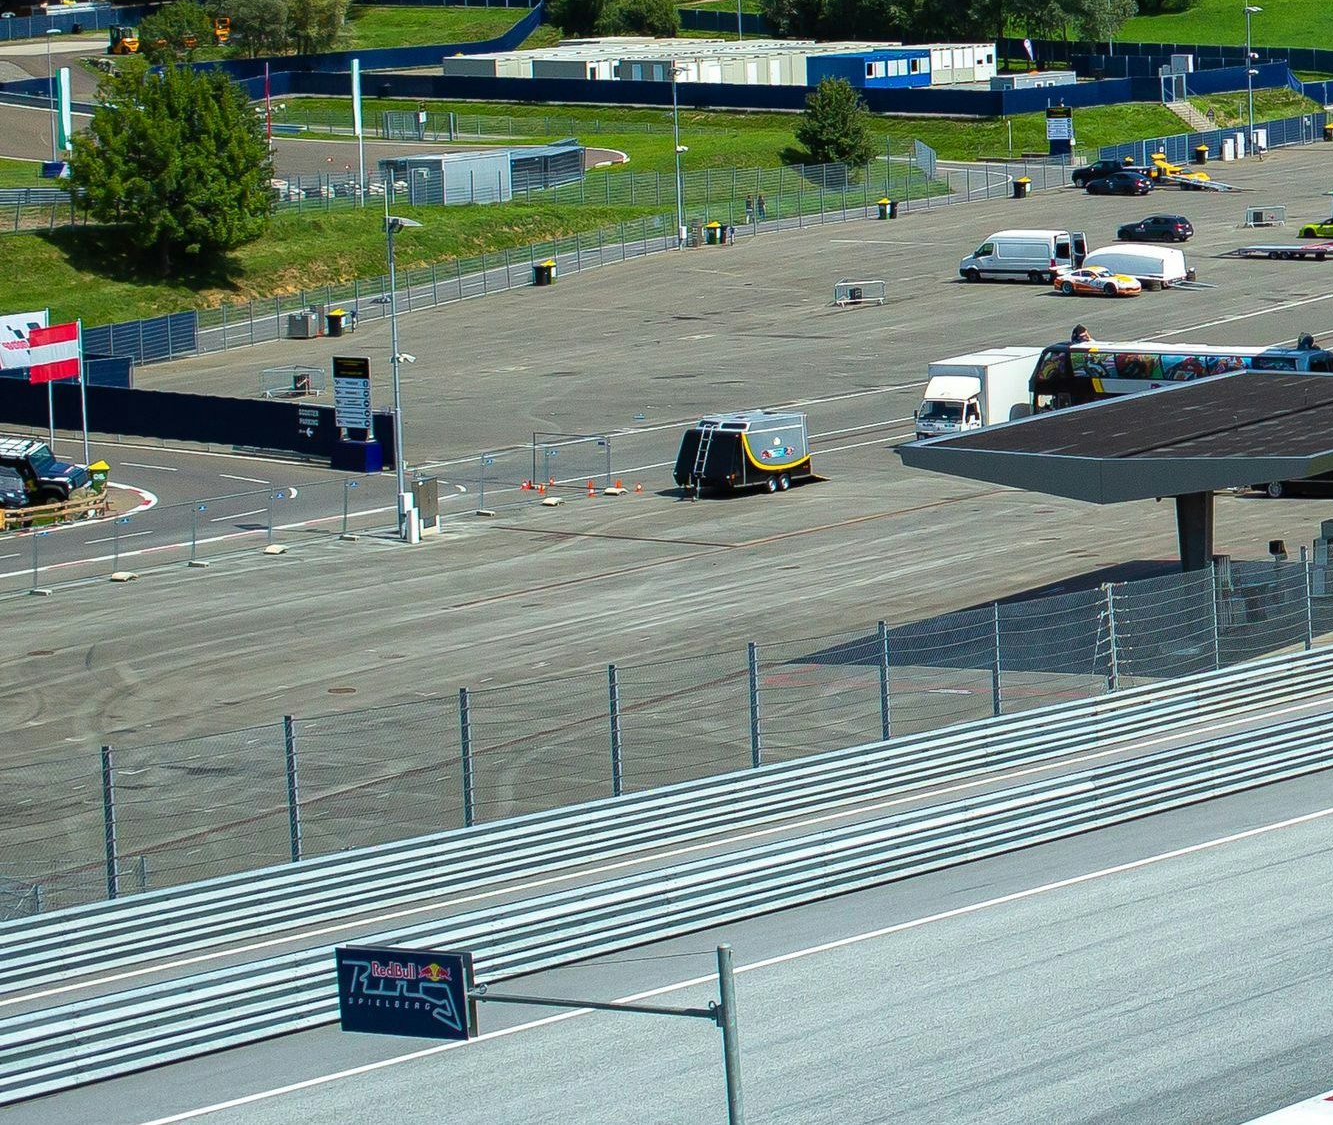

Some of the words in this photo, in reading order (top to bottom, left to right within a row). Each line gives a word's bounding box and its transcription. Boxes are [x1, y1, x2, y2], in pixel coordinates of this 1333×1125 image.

[371, 960, 393, 978] Red
[393, 962, 417, 980] Bull
[342, 960, 462, 1031] Ring
[348, 997, 431, 1010] SPIELBERG
